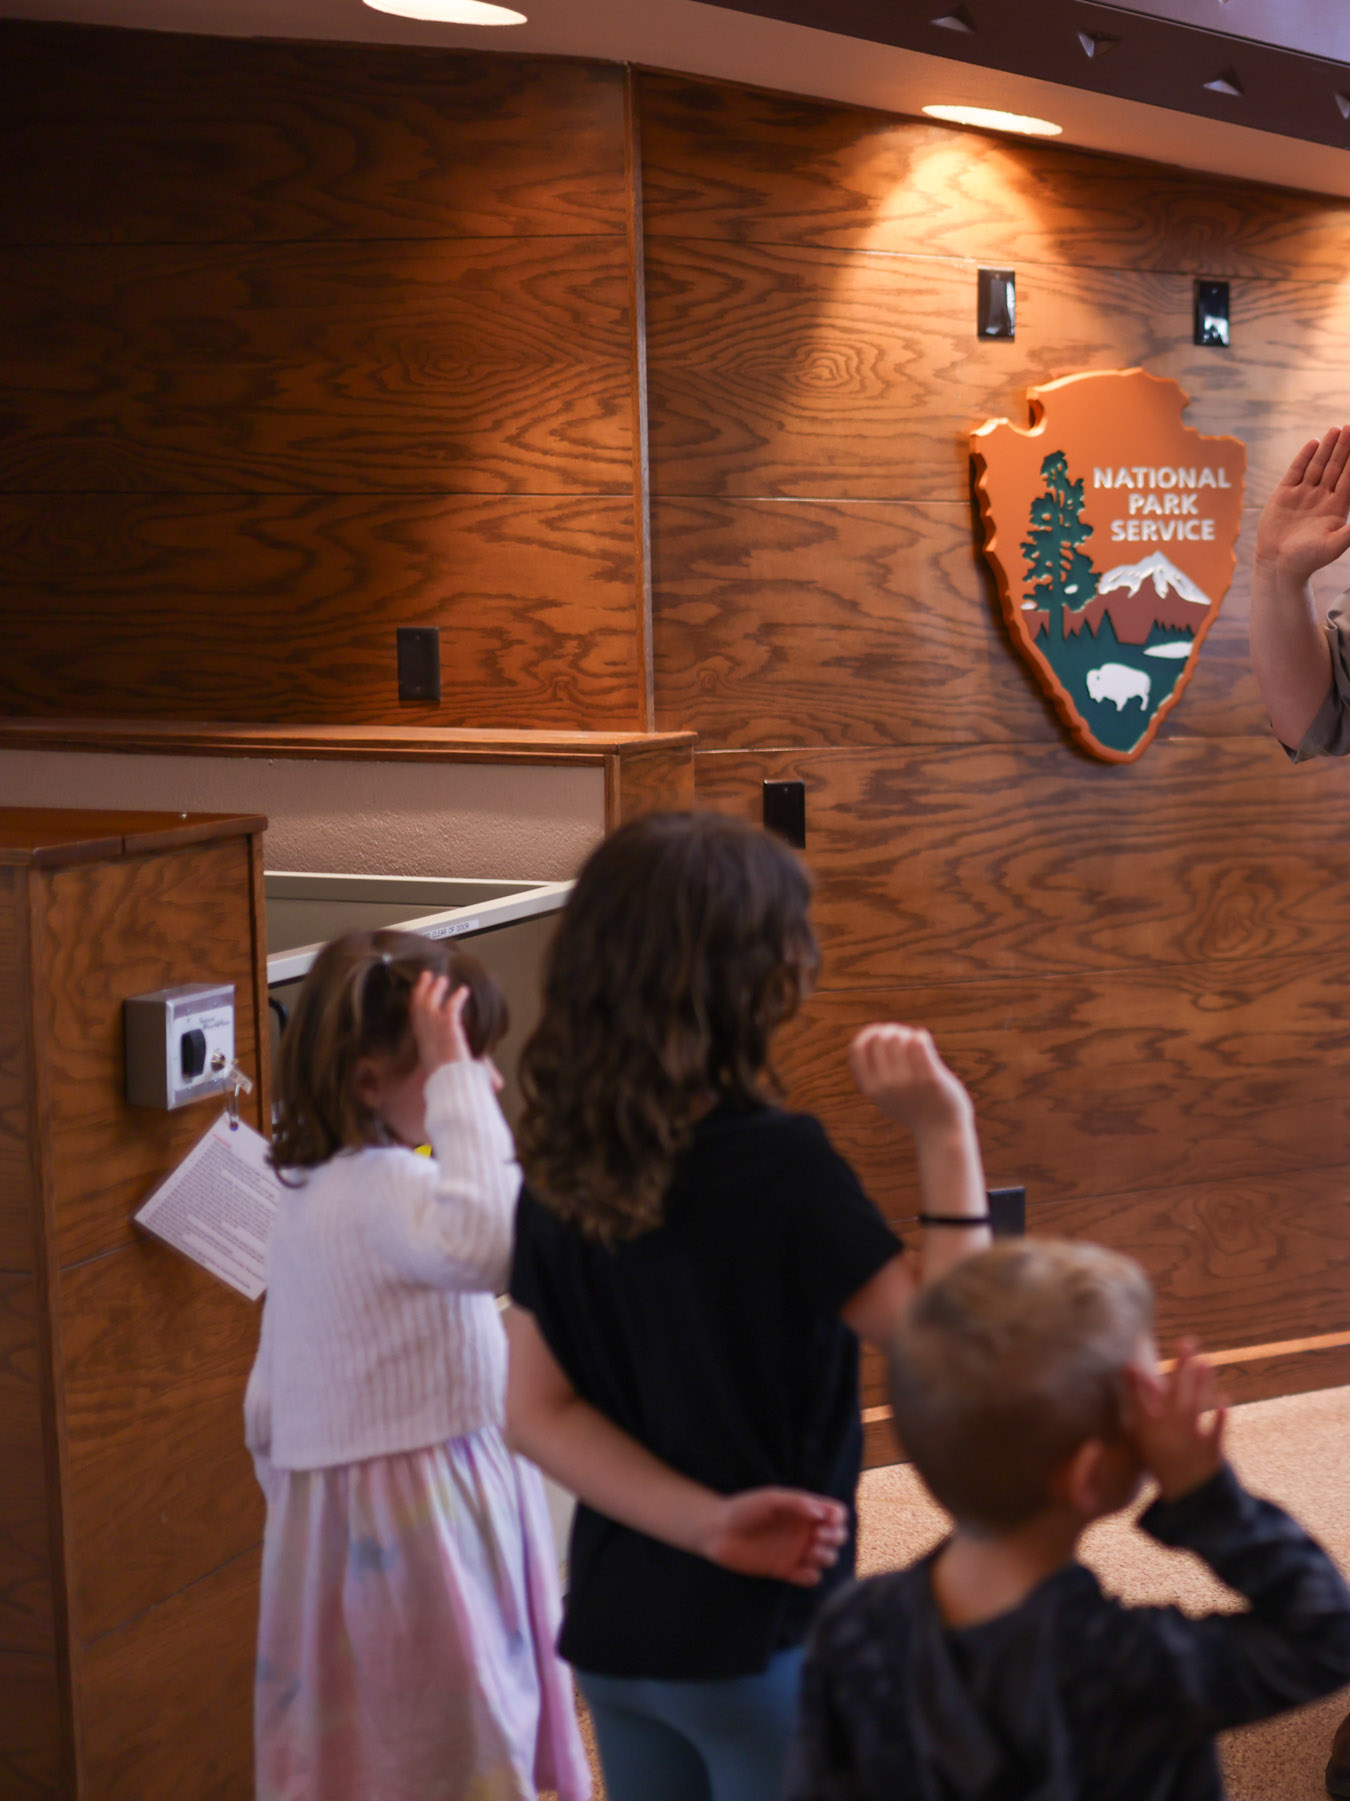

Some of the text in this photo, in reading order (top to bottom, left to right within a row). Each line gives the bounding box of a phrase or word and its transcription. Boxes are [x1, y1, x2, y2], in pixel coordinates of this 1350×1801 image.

[1093, 466, 1232, 489] NATIONAL
[1128, 493, 1198, 515] PARK
[1111, 519, 1215, 541] SERVICE
[448, 926, 455, 934] OF
[456, 922, 470, 932] DOOR
